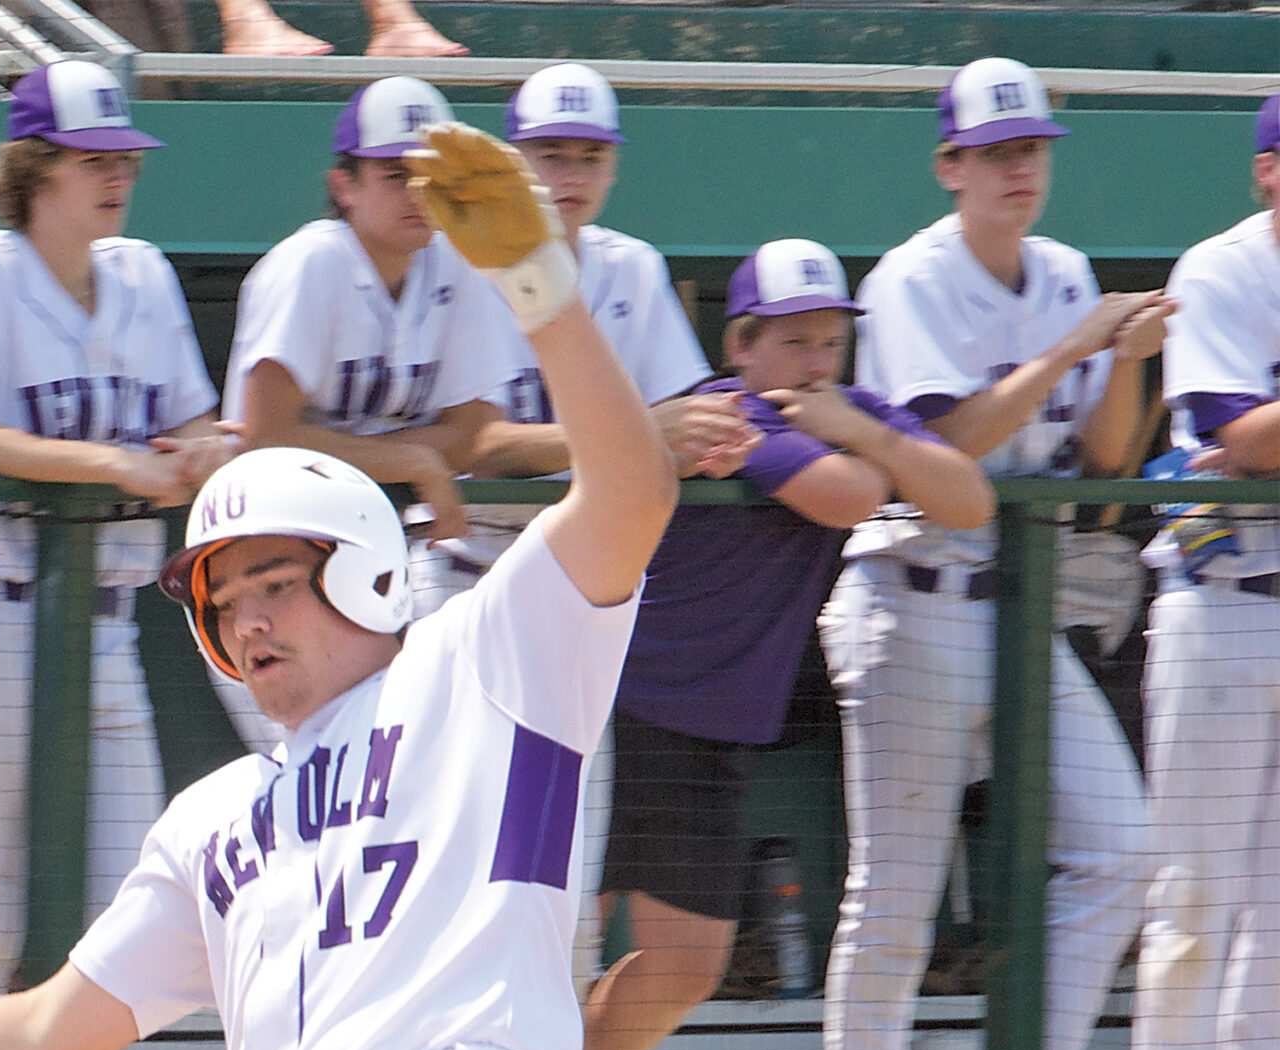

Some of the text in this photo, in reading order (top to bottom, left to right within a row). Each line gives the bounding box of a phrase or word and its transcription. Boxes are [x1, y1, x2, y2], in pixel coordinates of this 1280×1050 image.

[200, 482, 246, 535] NU
[297, 724, 404, 842] ULM
[319, 840, 419, 950] 17
